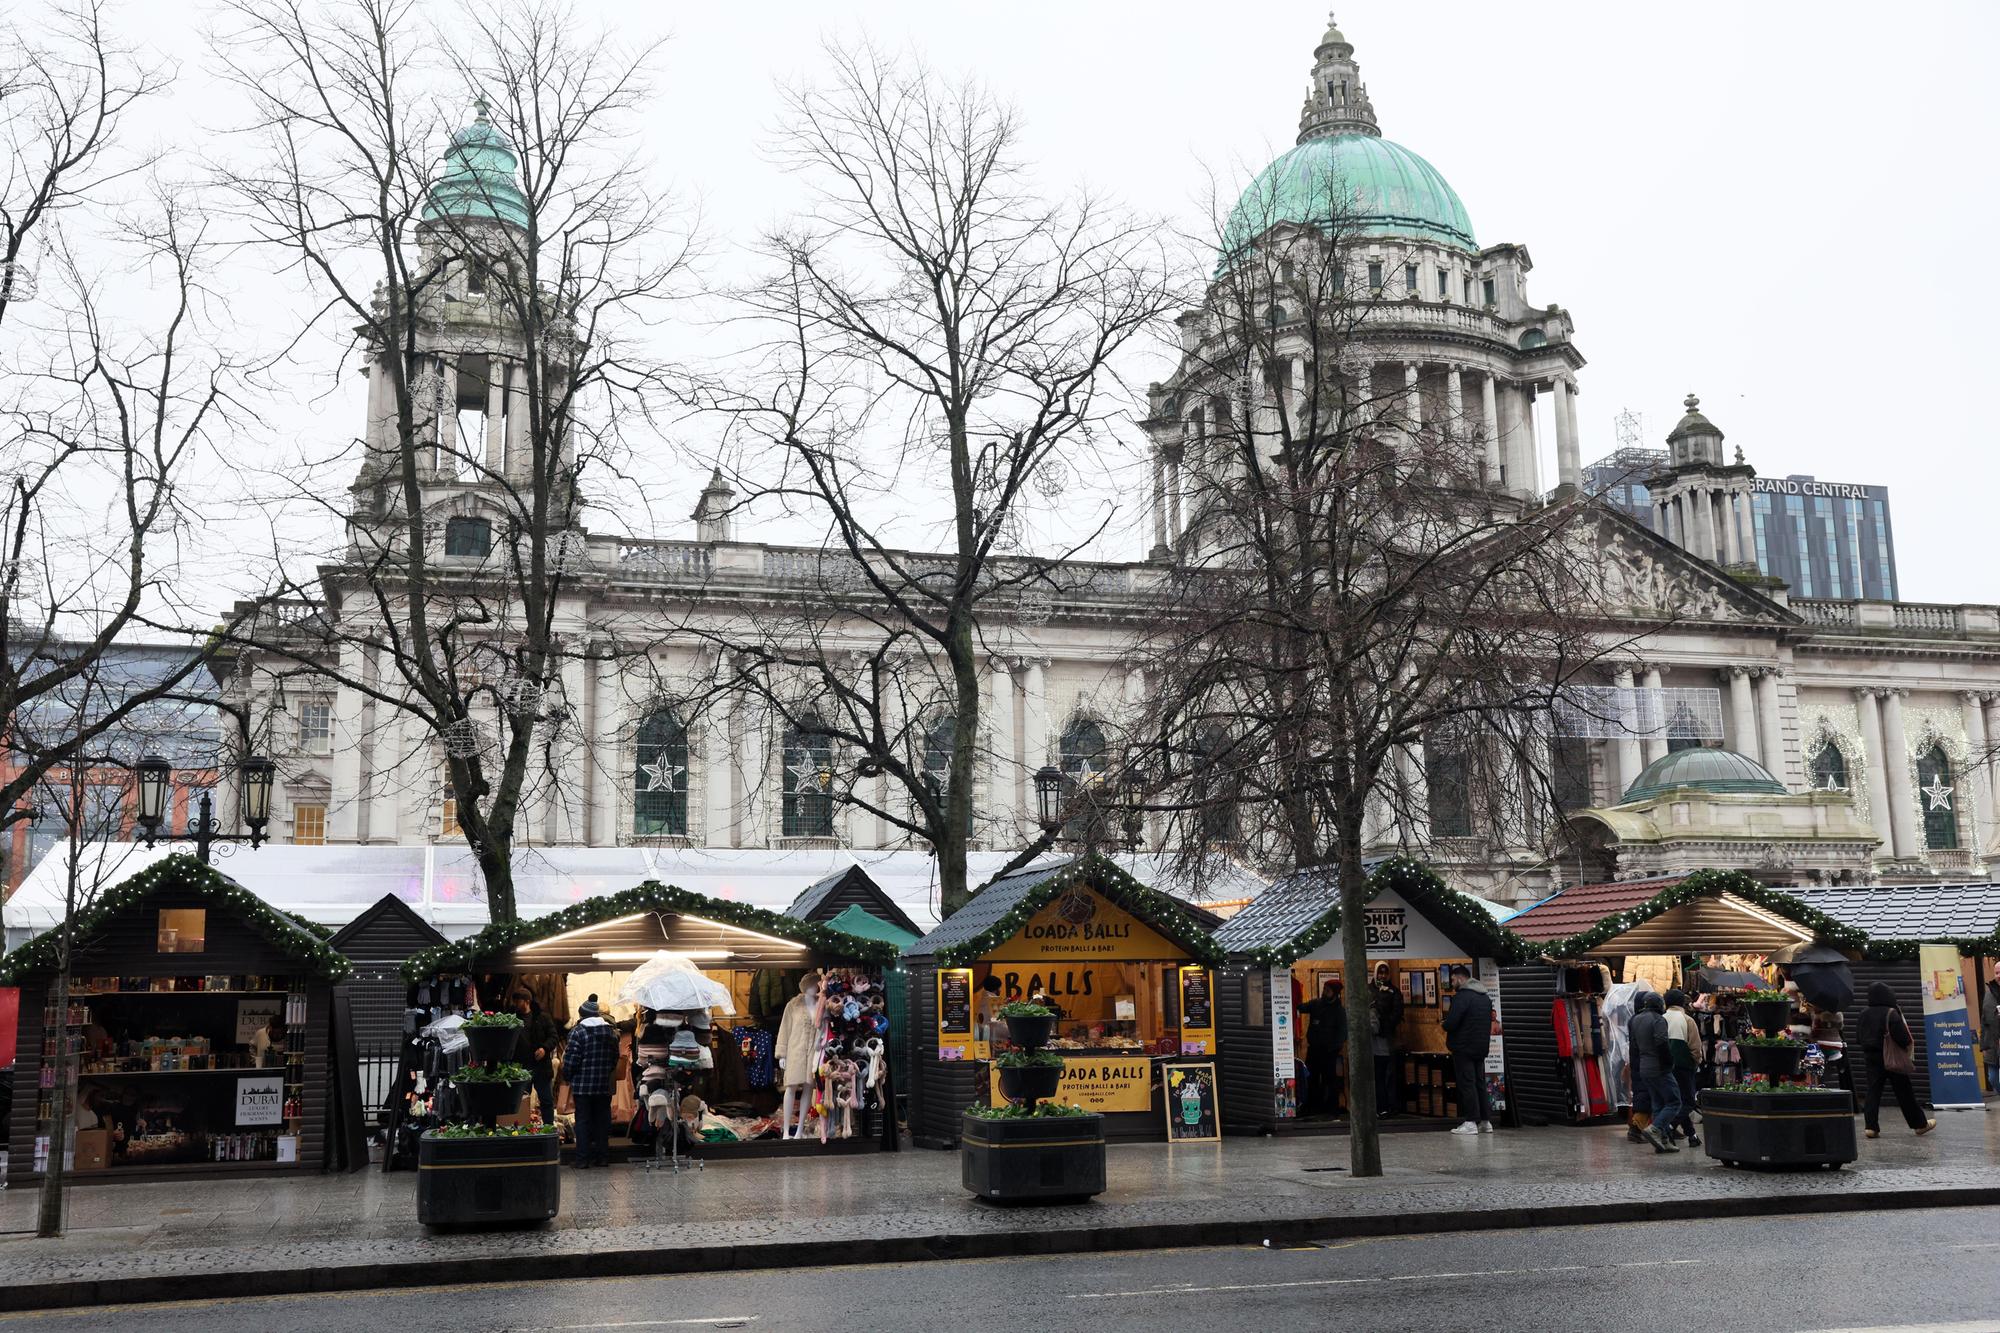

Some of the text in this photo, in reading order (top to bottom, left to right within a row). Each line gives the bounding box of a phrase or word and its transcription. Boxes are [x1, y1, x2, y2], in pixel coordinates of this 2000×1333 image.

[1749, 478, 1870, 499] GRAND CENTRAL
[1364, 913, 1405, 925] SHIRT
[1024, 923, 1130, 940] LOADA BALLS
[1040, 944, 1069, 953] PROTEIN
[1070, 944, 1090, 953] BALLS
[1097, 944, 1115, 953] BARS
[1004, 969, 1093, 1001] BALLS
[1939, 1041, 1957, 1049] Cooked
[1059, 1066, 1144, 1081] OADA BALLS
[1062, 1083, 1090, 1091] PROTEIN
[241, 1095, 279, 1105] DUBAI
